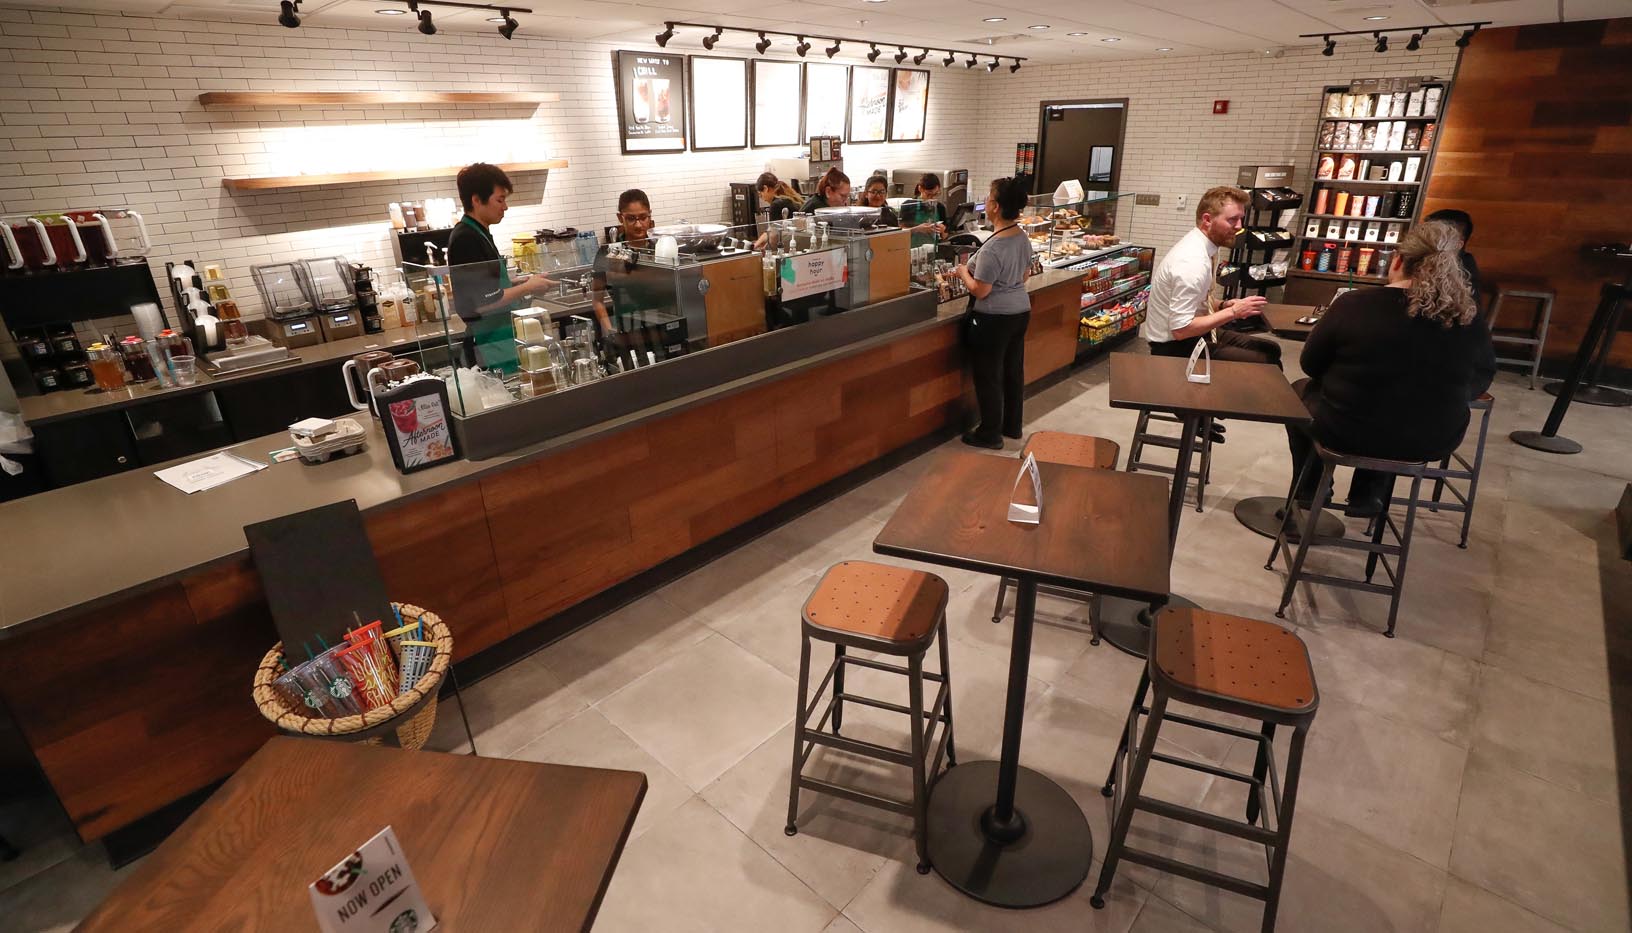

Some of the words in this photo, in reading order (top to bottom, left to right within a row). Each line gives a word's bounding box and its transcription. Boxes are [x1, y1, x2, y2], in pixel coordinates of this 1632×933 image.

[402, 422, 445, 447] Afternoon
[420, 431, 440, 443] MADE
[337, 890, 368, 922] NOW
[369, 864, 402, 897] OPEN
